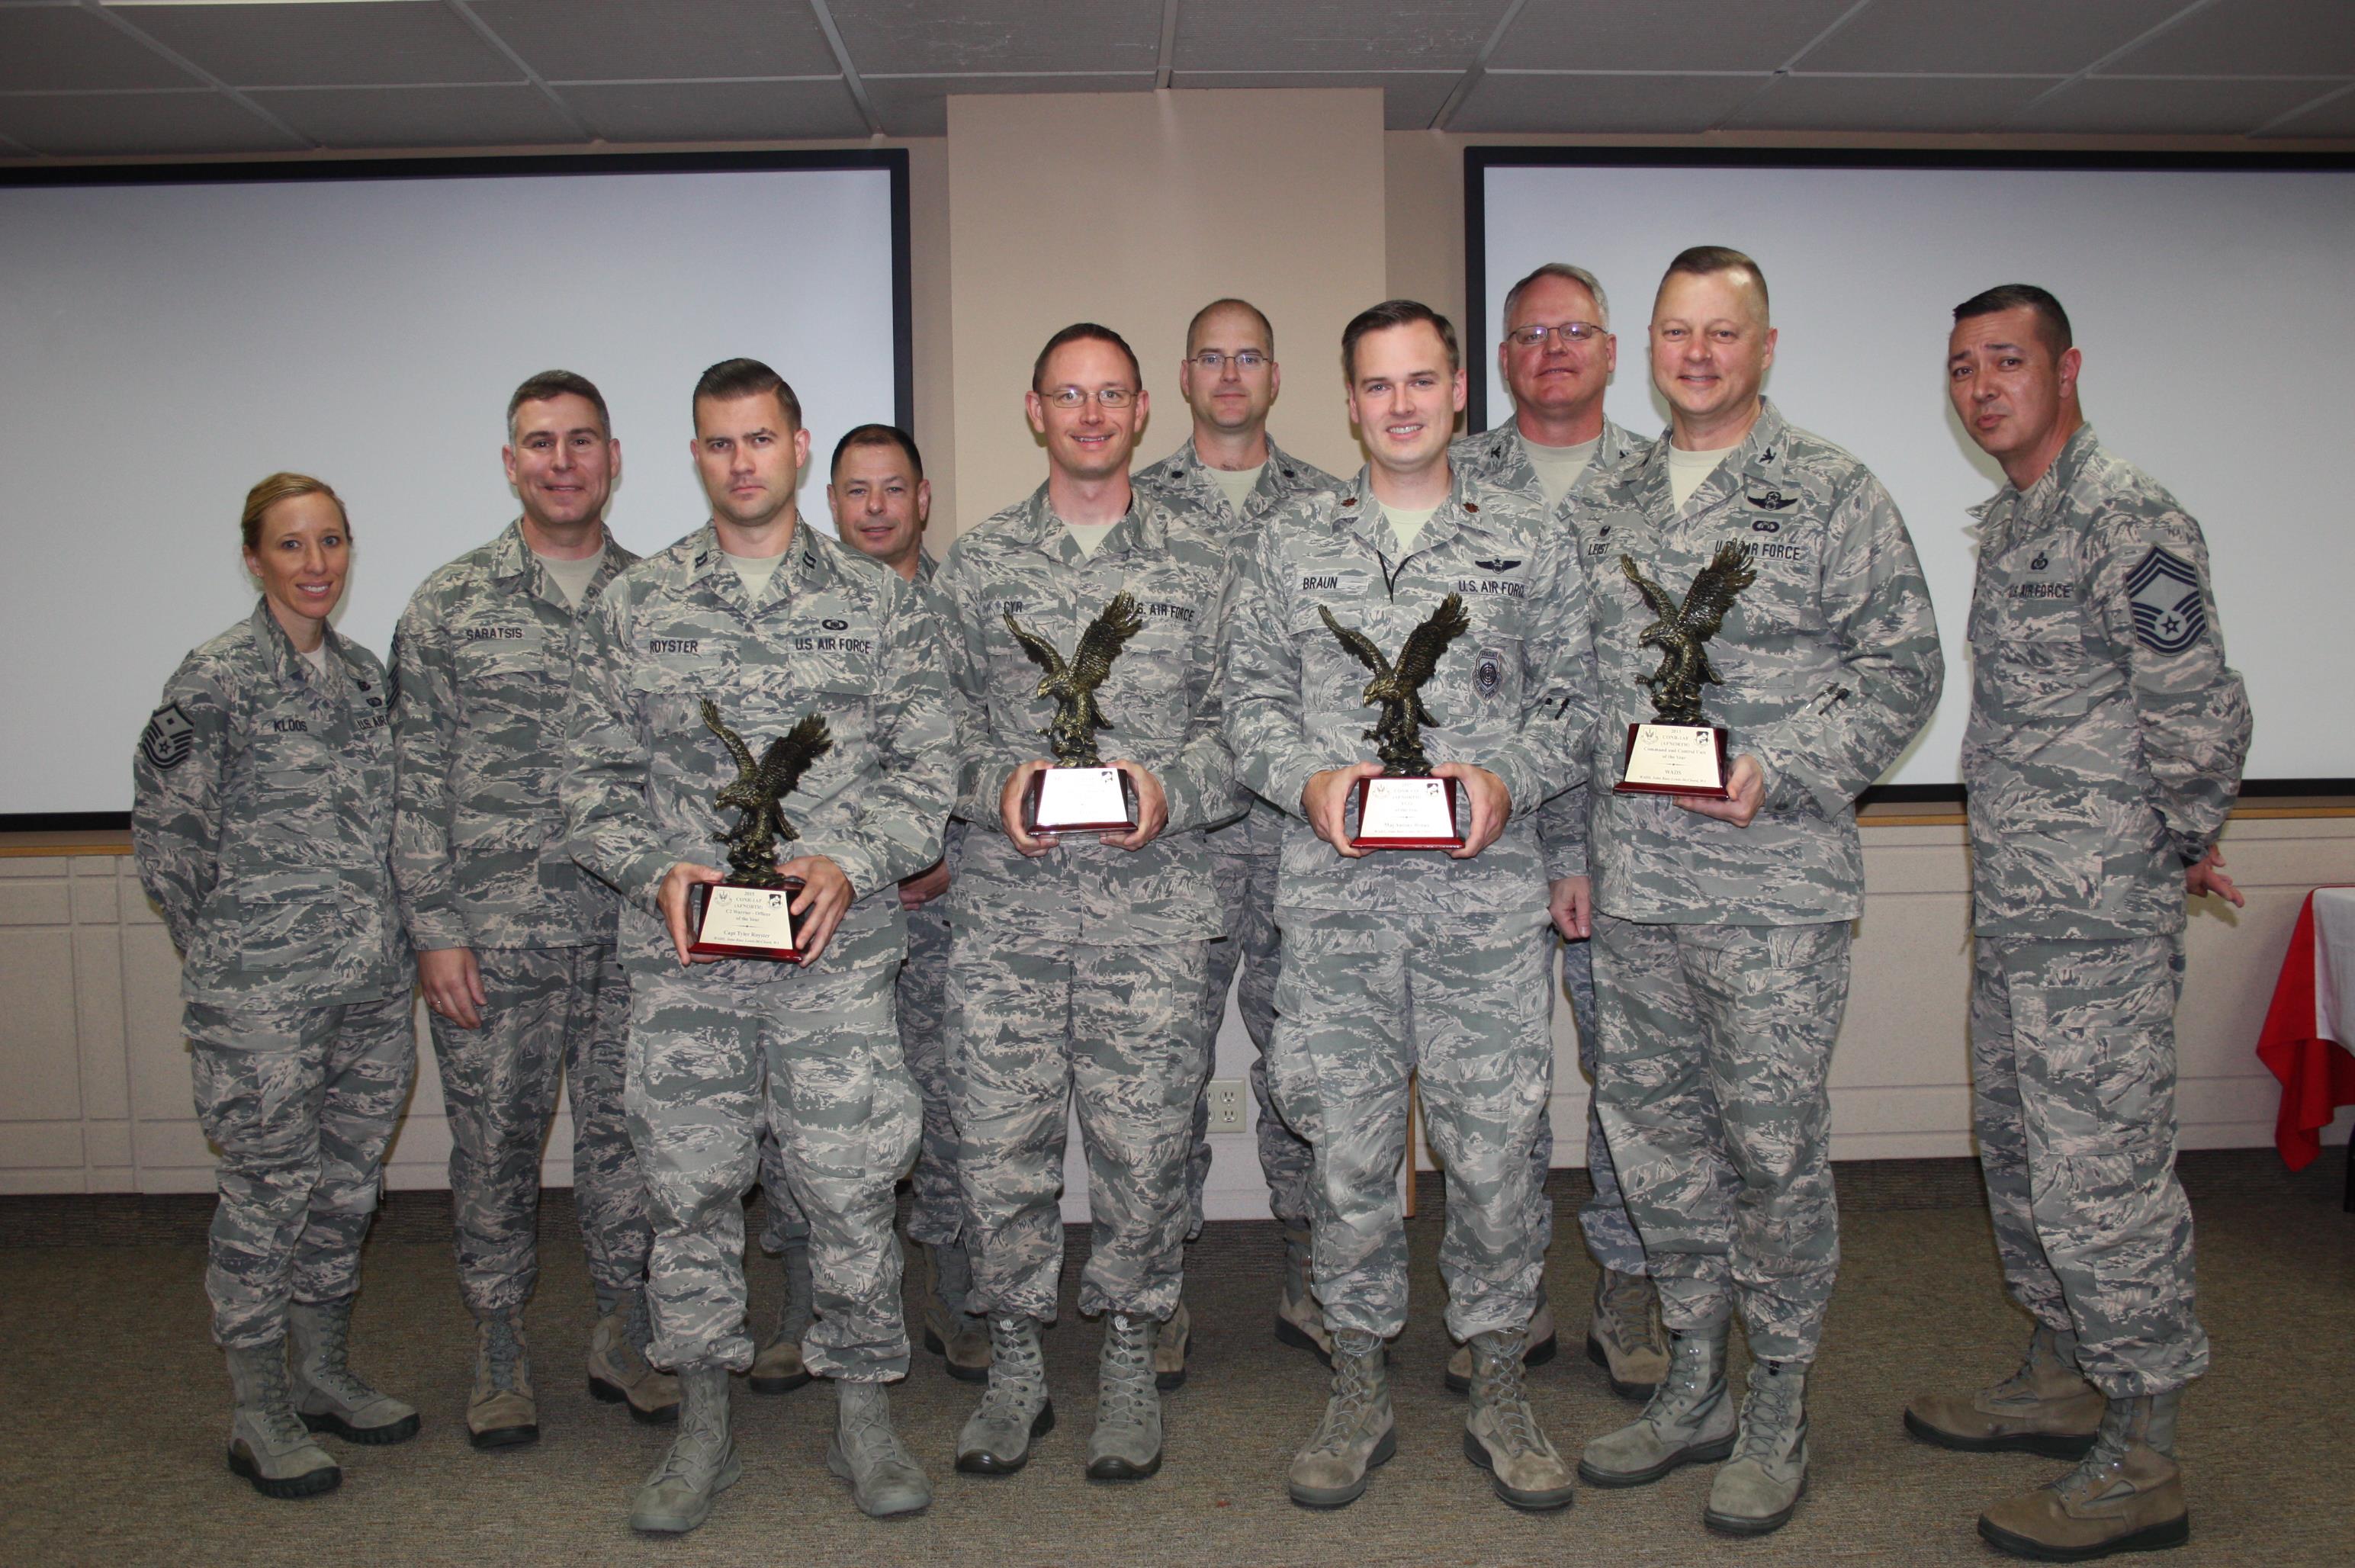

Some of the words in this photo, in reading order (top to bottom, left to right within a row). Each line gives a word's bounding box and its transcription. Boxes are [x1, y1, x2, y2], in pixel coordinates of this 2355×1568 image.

[1588, 542, 1611, 556] LEIST
[1762, 544, 1800, 561] FORCE
[1303, 577, 1338, 590] BRAUN
[1458, 580, 1478, 592] U.S.
[1481, 580, 1498, 593] AIR
[1502, 581, 1524, 598] FORC
[2035, 584, 2071, 598] FORCE
[1004, 601, 1023, 613] CYR
[1149, 603, 1167, 616] AIR
[1171, 606, 1195, 622] FORCE
[466, 627, 523, 641] SARATSIS
[650, 639, 699, 654] ROYSTER
[818, 638, 836, 651] AIR
[839, 638, 870, 654] FORCE
[274, 718, 308, 732] KLOOS
[372, 715, 387, 728] AIR
